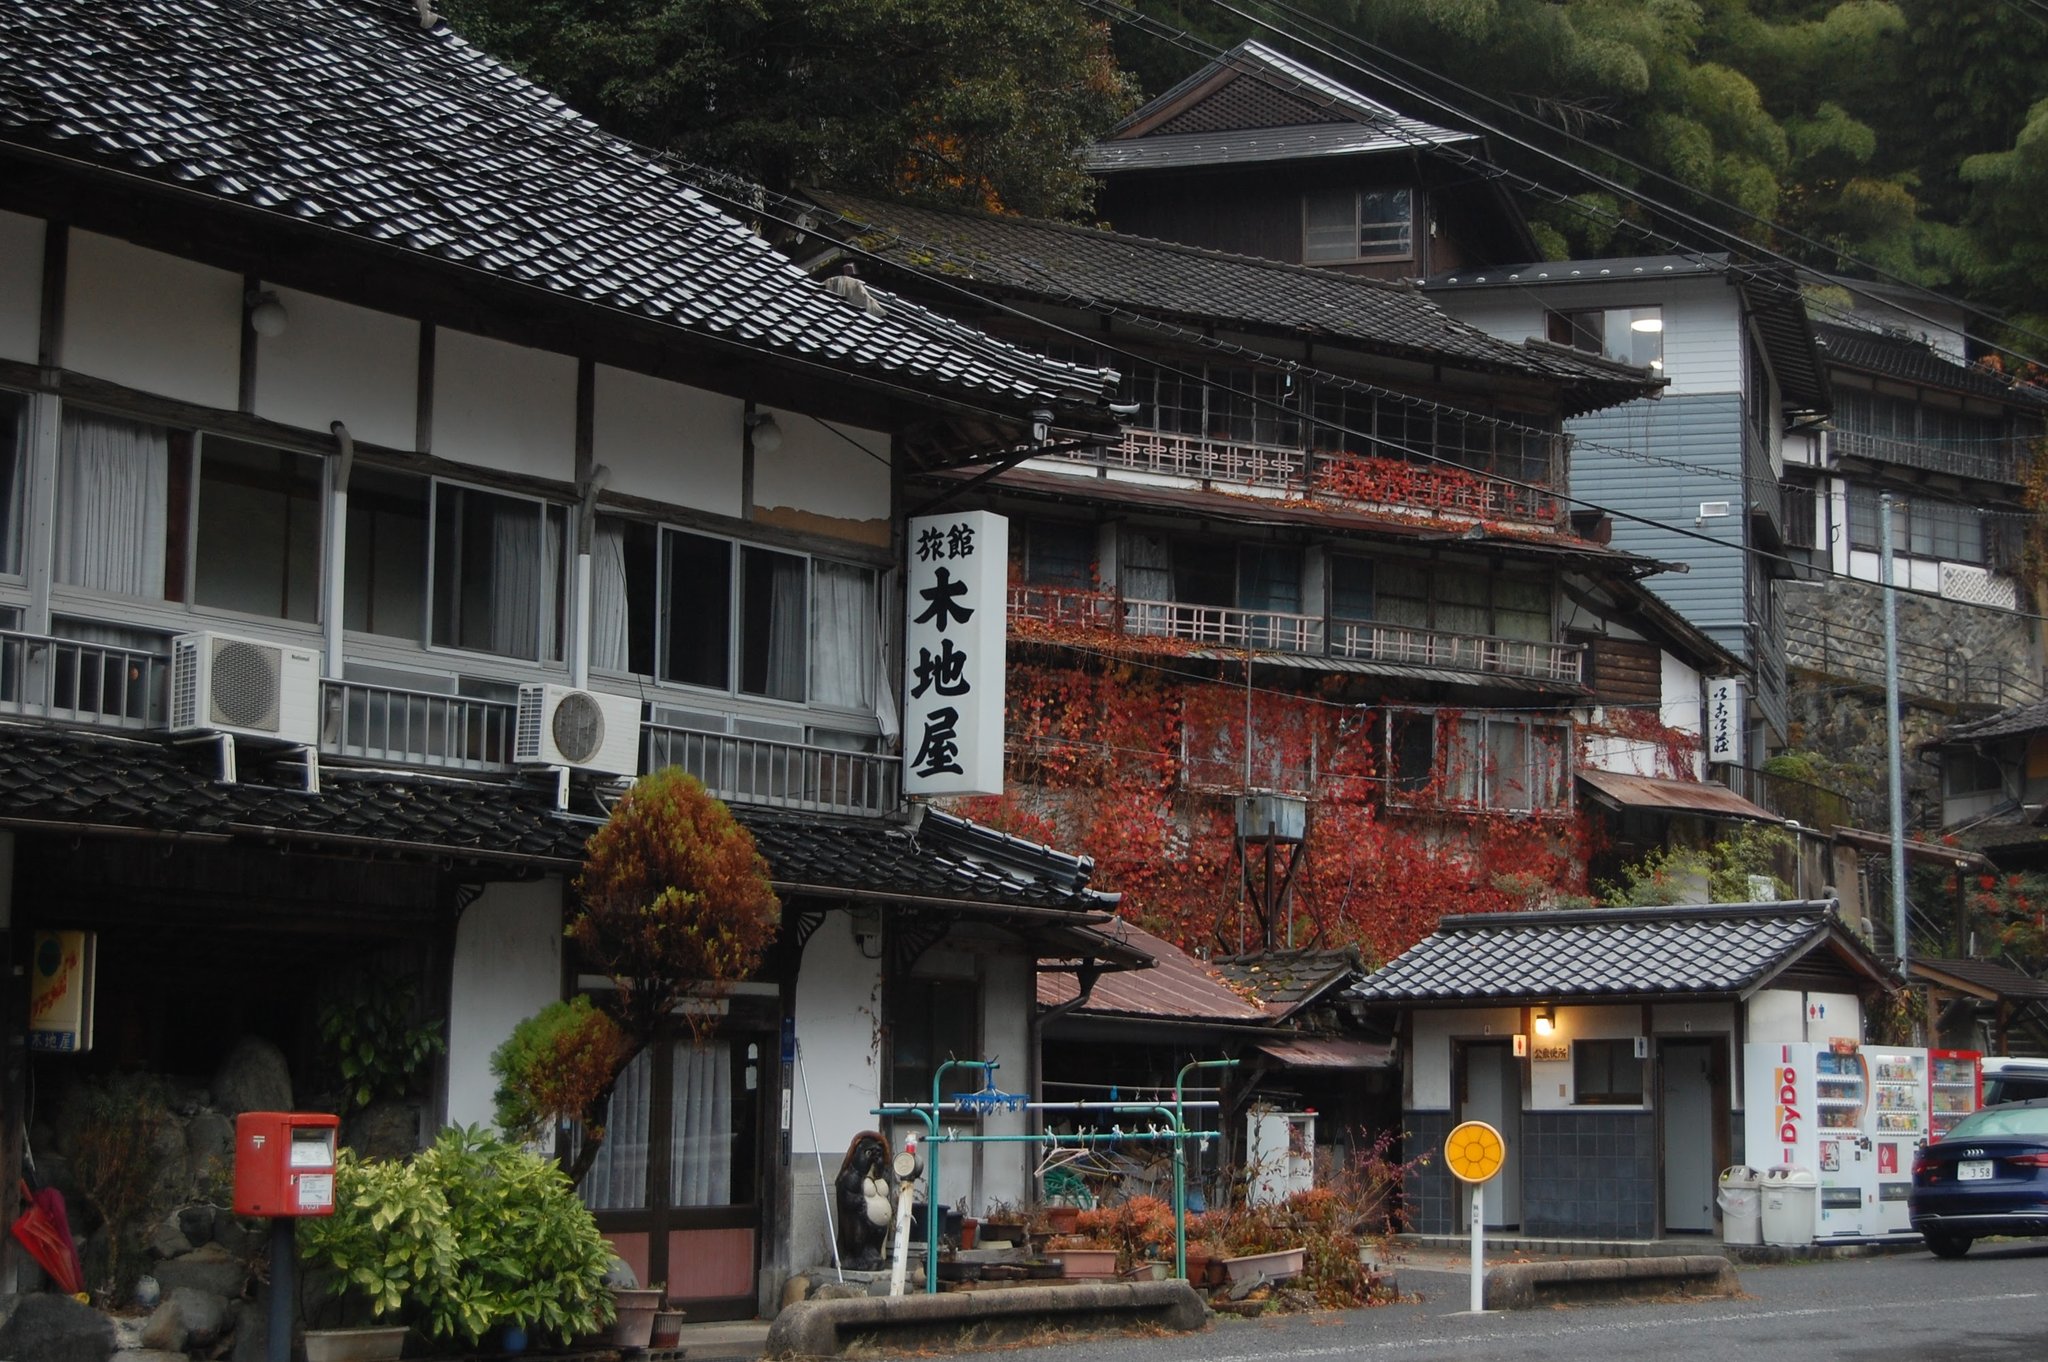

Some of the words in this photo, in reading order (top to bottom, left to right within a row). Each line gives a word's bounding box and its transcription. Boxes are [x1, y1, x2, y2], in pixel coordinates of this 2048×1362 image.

[915, 522, 976, 562] 旅館
[910, 566, 975, 778] 木地屋
[31, 1032, 72, 1050] 木地屋
[1780, 1067, 1801, 1143] DyDo
